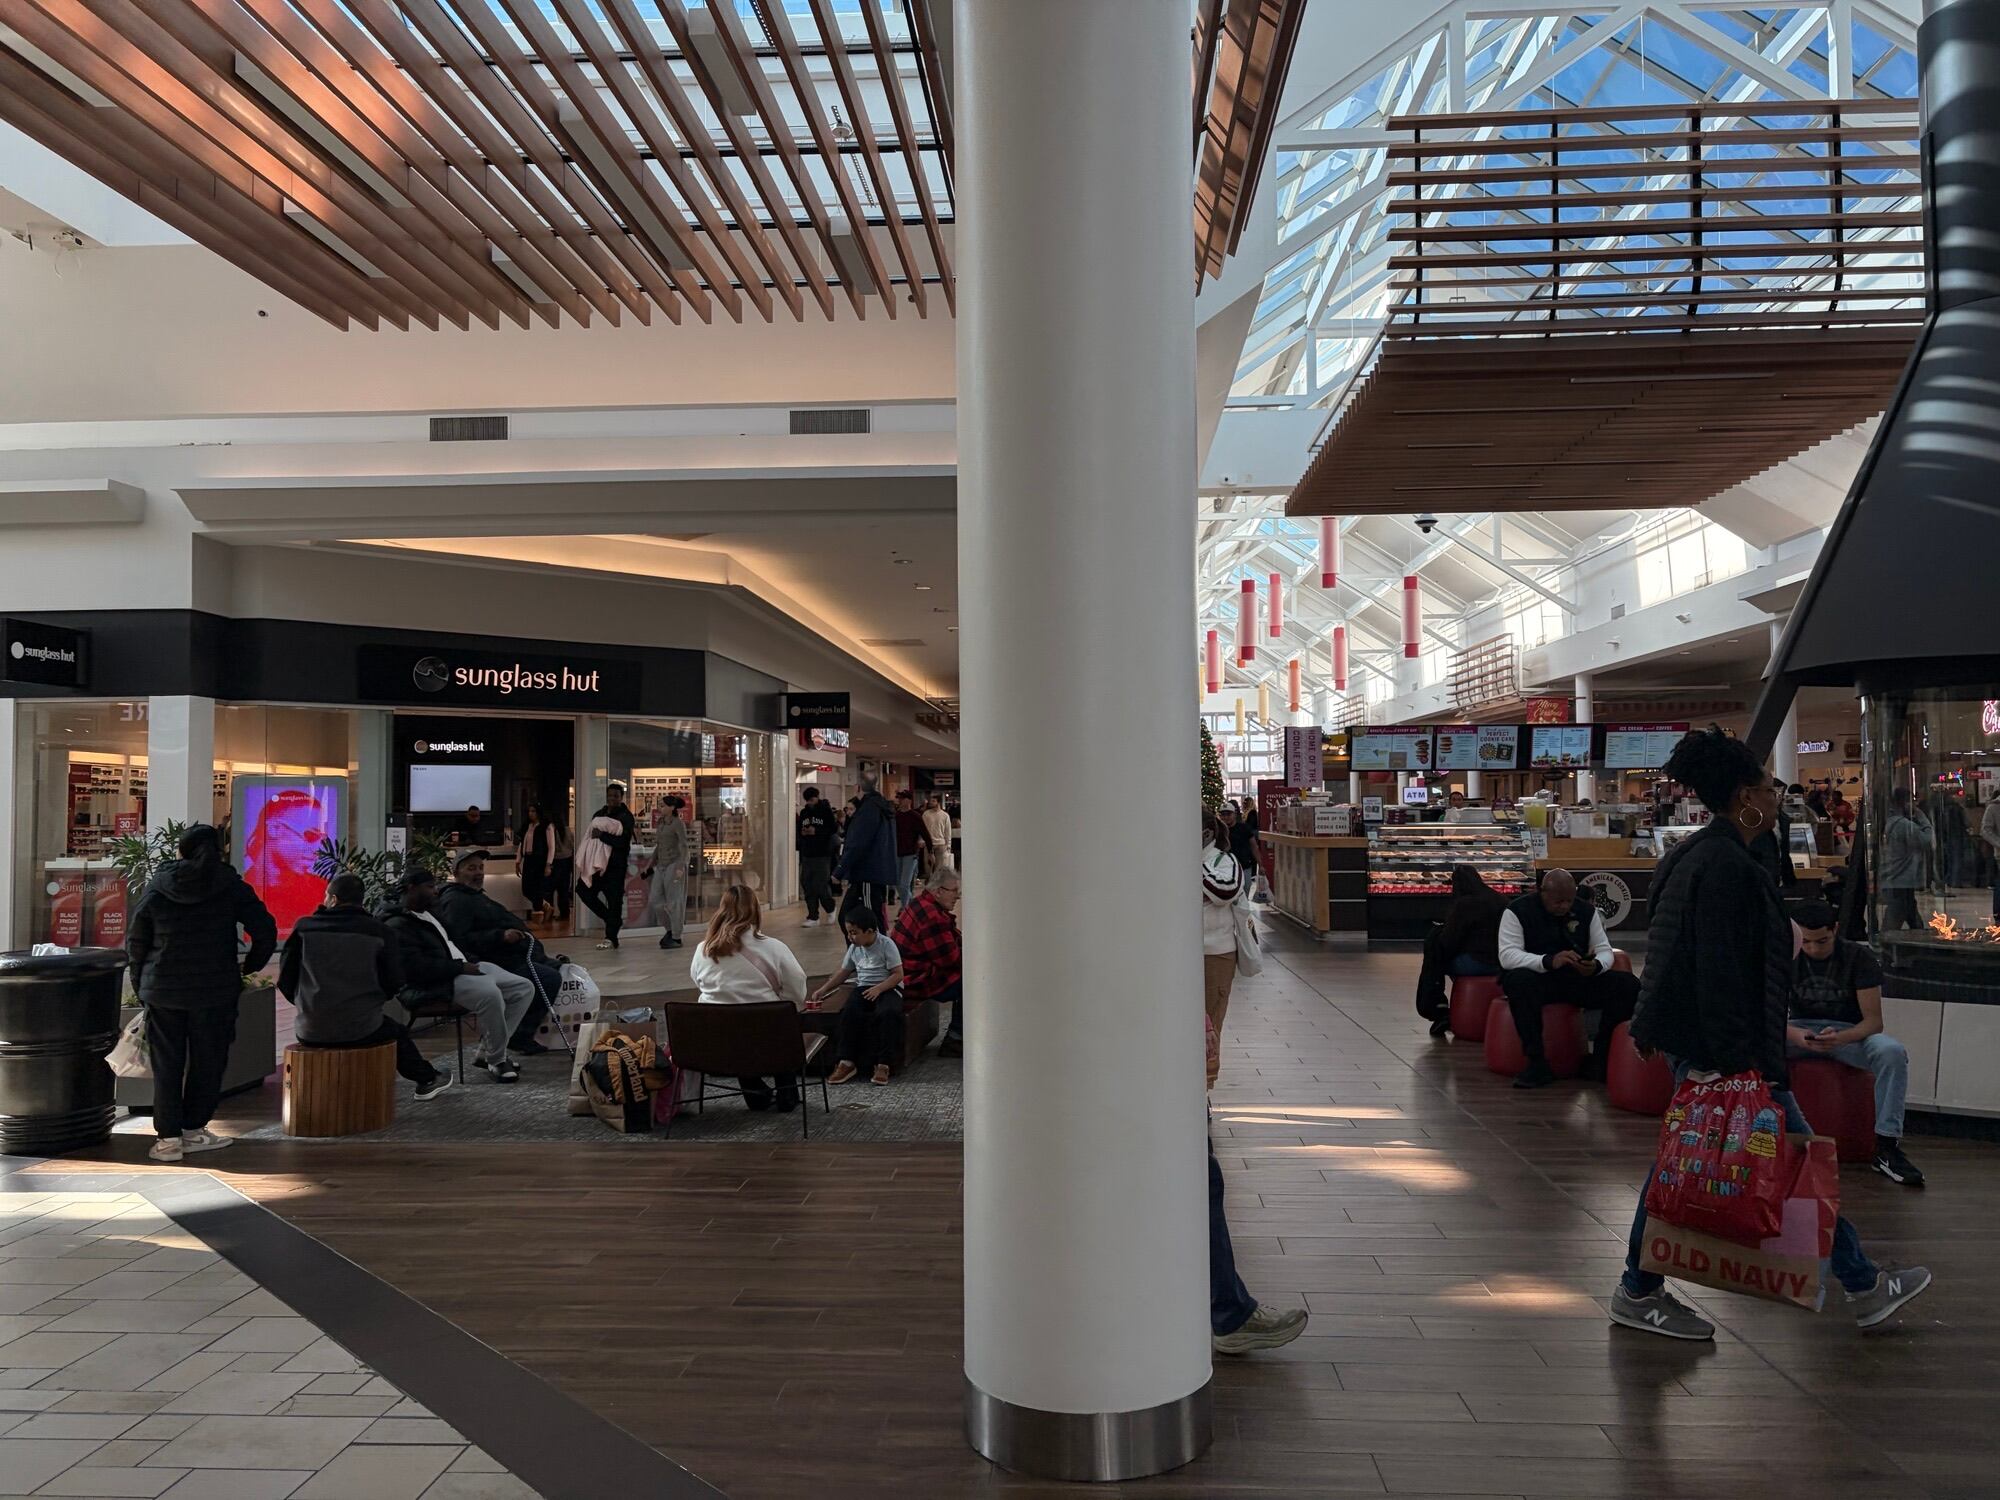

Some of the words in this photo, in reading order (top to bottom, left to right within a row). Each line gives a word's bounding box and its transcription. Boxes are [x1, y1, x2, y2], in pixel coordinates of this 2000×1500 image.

[25, 646, 60, 661] sunglass
[61, 648, 75, 662] hut
[455, 663, 557, 694] sunglass
[562, 666, 600, 692] hut
[802, 706, 832, 716] sunglass
[833, 705, 846, 713] hut
[429, 741, 468, 753] sunglass
[469, 741, 484, 752] hut
[1586, 873, 1614, 885] AMERICAN
[1614, 879, 1630, 901] COOKIES
[1651, 1237, 1711, 1273] OLD
[1720, 1257, 1809, 1298] NAVY
